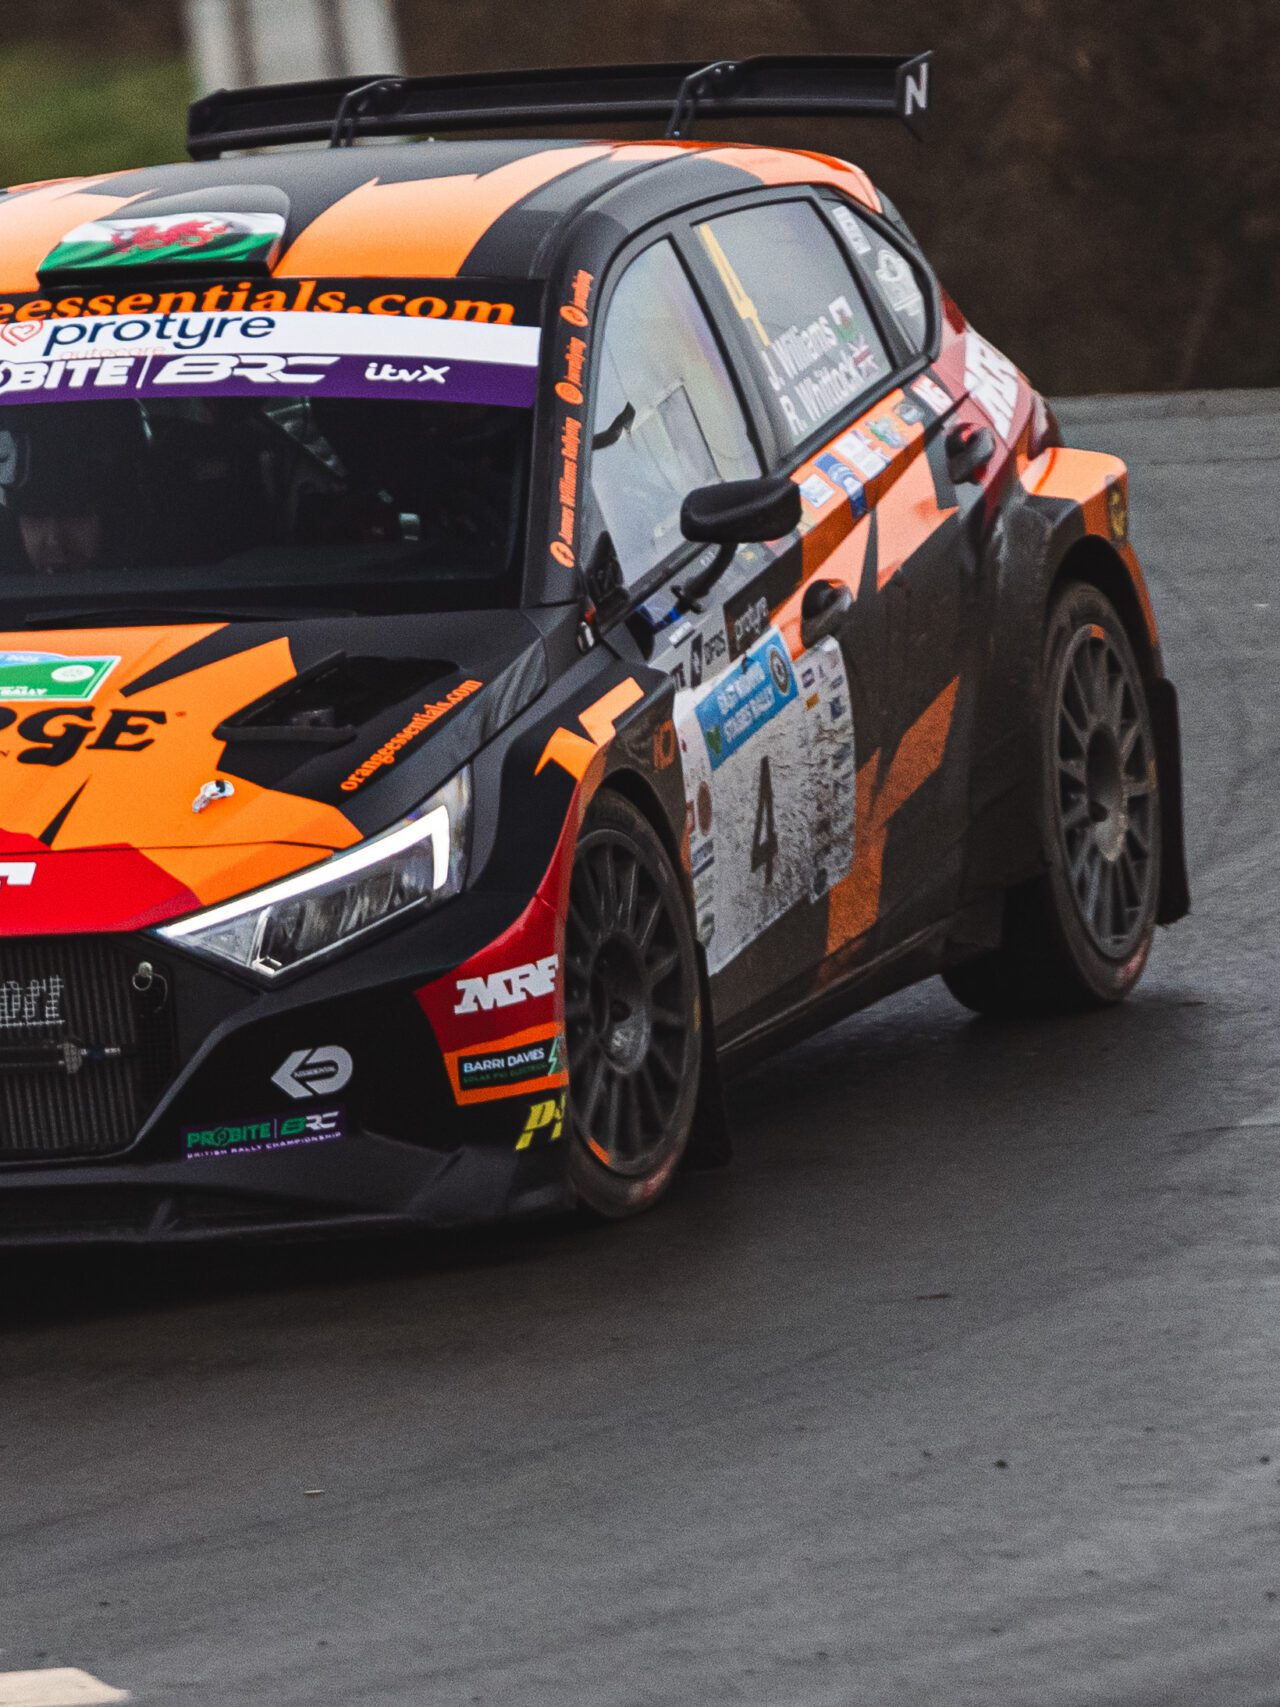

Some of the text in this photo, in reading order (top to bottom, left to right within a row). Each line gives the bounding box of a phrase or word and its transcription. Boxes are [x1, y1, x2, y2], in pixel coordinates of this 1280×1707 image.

[905, 63, 928, 115] N
[42, 312, 276, 357] protyre
[772, 315, 837, 379] Williams
[152, 354, 341, 385] BRC
[364, 361, 451, 386] itvX
[794, 349, 865, 422] Whittock
[340, 680, 483, 791] orangeessentials.com
[749, 755, 778, 884] 4
[454, 953, 559, 1015] MRF
[463, 1047, 545, 1074] BARRI DAVIES
[187, 1111, 340, 1148] PROBITE BRC
[230, 1145, 262, 1154] RALLY
